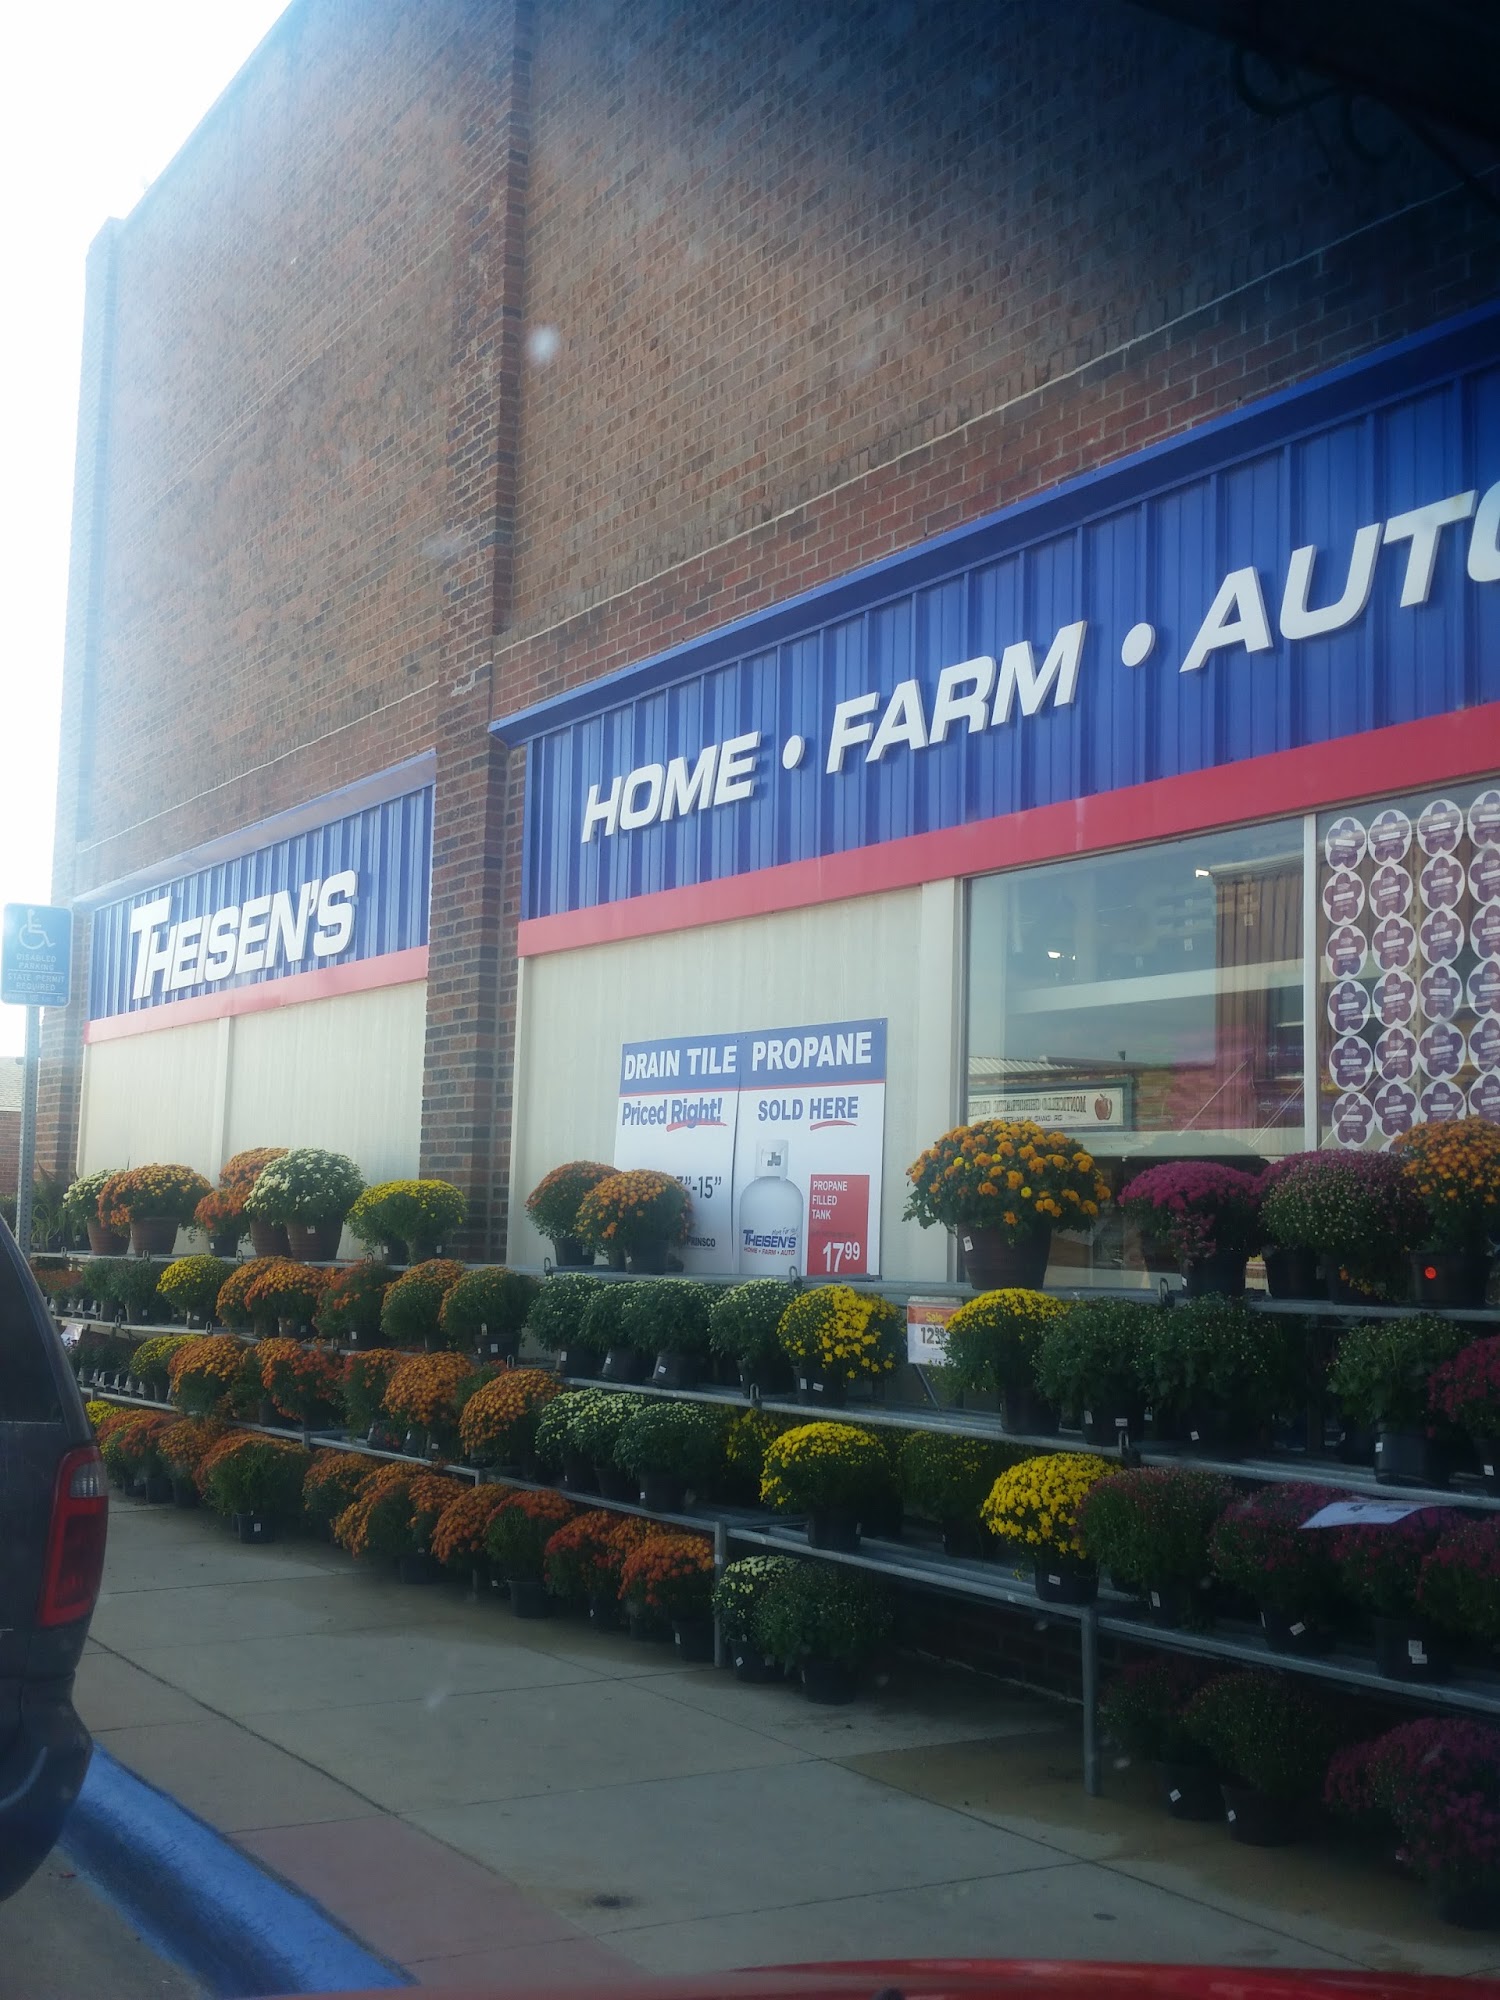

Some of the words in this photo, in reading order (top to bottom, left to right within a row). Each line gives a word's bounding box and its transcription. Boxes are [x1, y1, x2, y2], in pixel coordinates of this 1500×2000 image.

[581, 730, 761, 844] HOME
[825, 620, 1087, 774] FARM
[130, 869, 357, 999] THEISEN'S
[16, 953, 56, 962] DISABLED
[18, 962, 54, 970] PARKING
[752, 1031, 872, 1072] PROPANE
[624, 1049, 680, 1081] DRAIN
[687, 1045, 737, 1075] TILE
[622, 1098, 667, 1126] Priced
[670, 1097, 723, 1129] Right!
[758, 1099, 803, 1122] SOLD
[809, 1096, 859, 1120] HERE
[812, 1180, 848, 1192] PROPANE
[812, 1194, 837, 1206] FILLED
[812, 1209, 831, 1220] TANK
[743, 1229, 797, 1248] THEISEN'S
[926, 1312, 943, 1322] Sale
